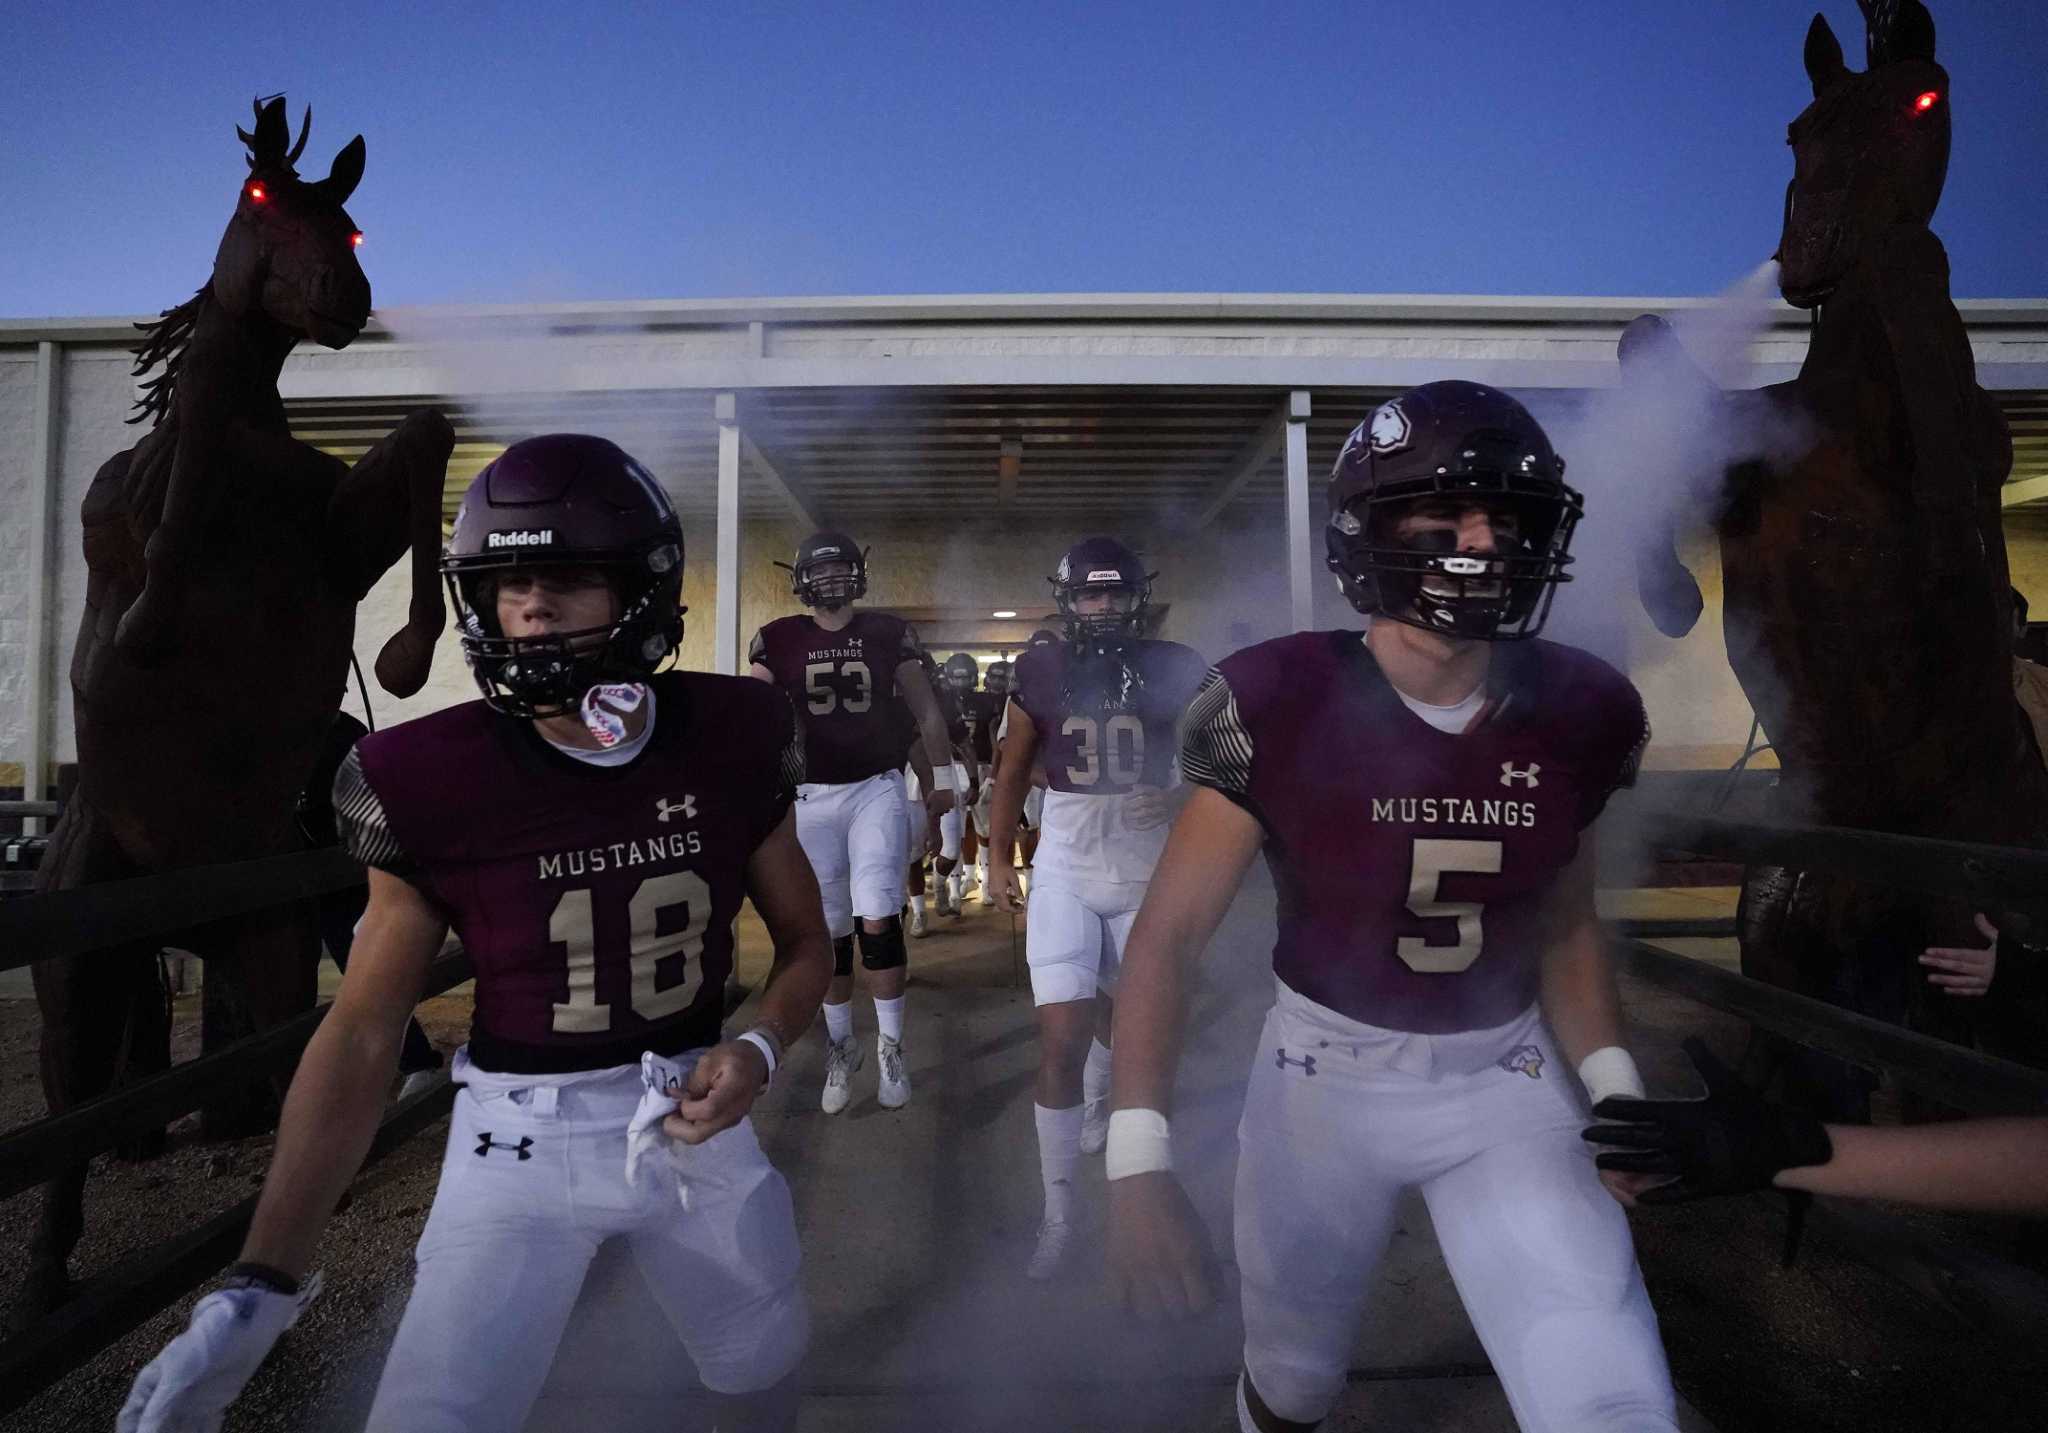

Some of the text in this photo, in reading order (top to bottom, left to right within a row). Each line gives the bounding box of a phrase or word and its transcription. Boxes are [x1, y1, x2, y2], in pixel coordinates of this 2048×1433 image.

[488, 529, 553, 548] Riddell
[808, 648, 863, 660] MUSTANGS
[805, 661, 872, 716] 53
[1061, 715, 1145, 786] 30
[1371, 798, 1537, 828] MUSTANGS
[537, 830, 702, 880] MUSTANGS
[1397, 838, 1504, 974] 5
[548, 869, 712, 1033] 18
